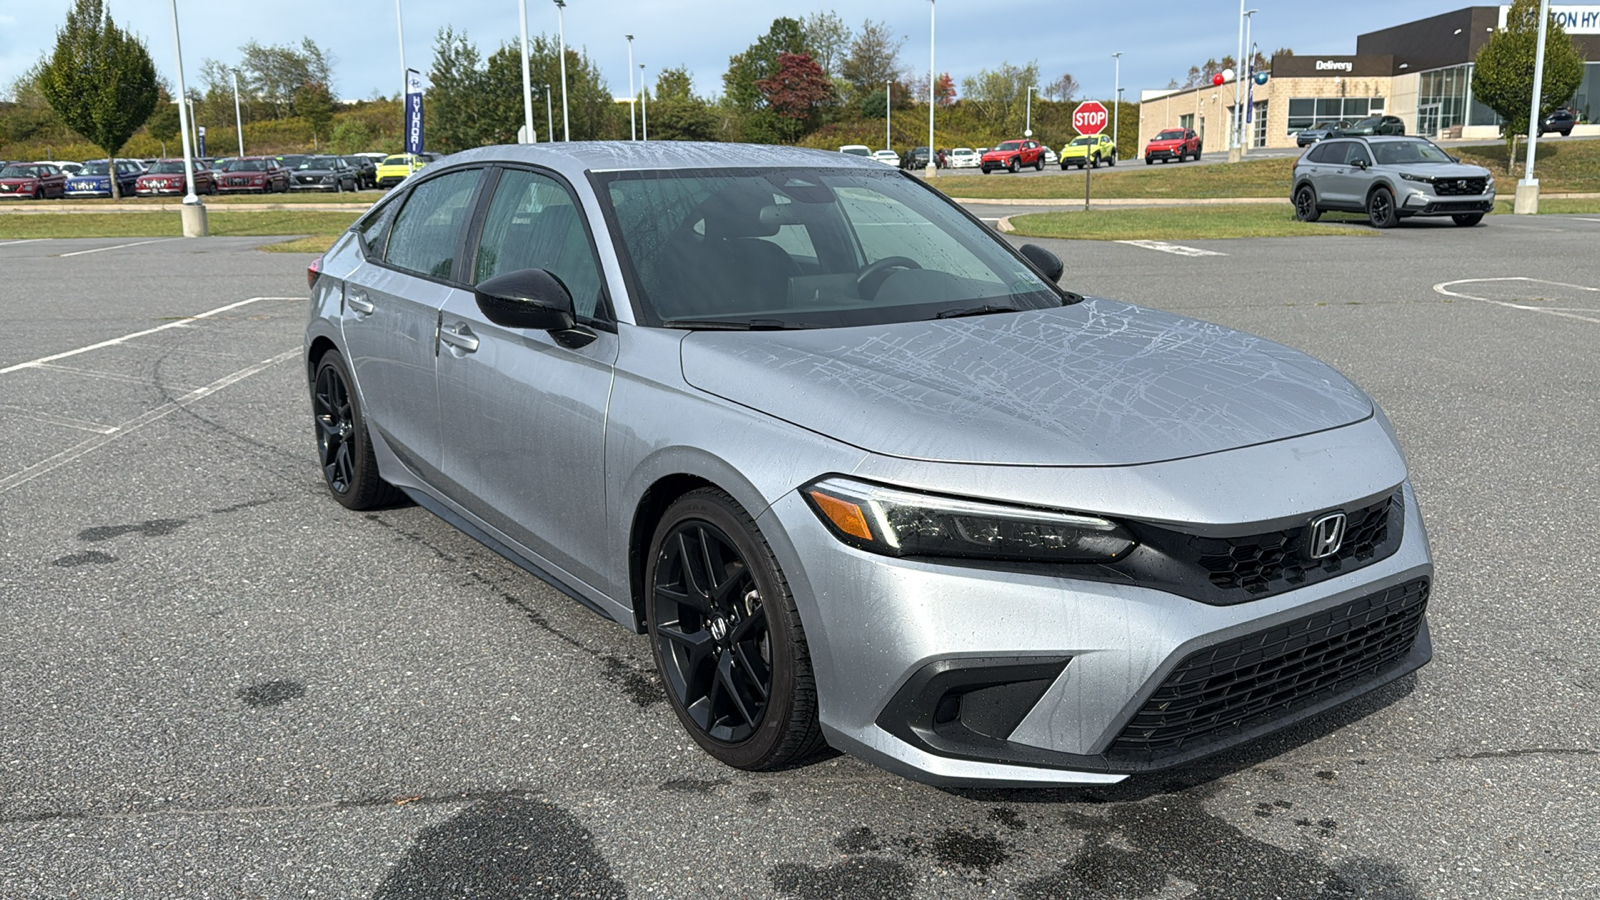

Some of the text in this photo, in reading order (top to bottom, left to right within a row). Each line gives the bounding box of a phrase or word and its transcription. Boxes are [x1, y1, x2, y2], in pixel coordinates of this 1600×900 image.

[1581, 11, 1600, 28] HY
[1316, 60, 1353, 72] Delivery
[410, 95, 421, 152] HYUNDAI
[1075, 111, 1106, 127] STOP
